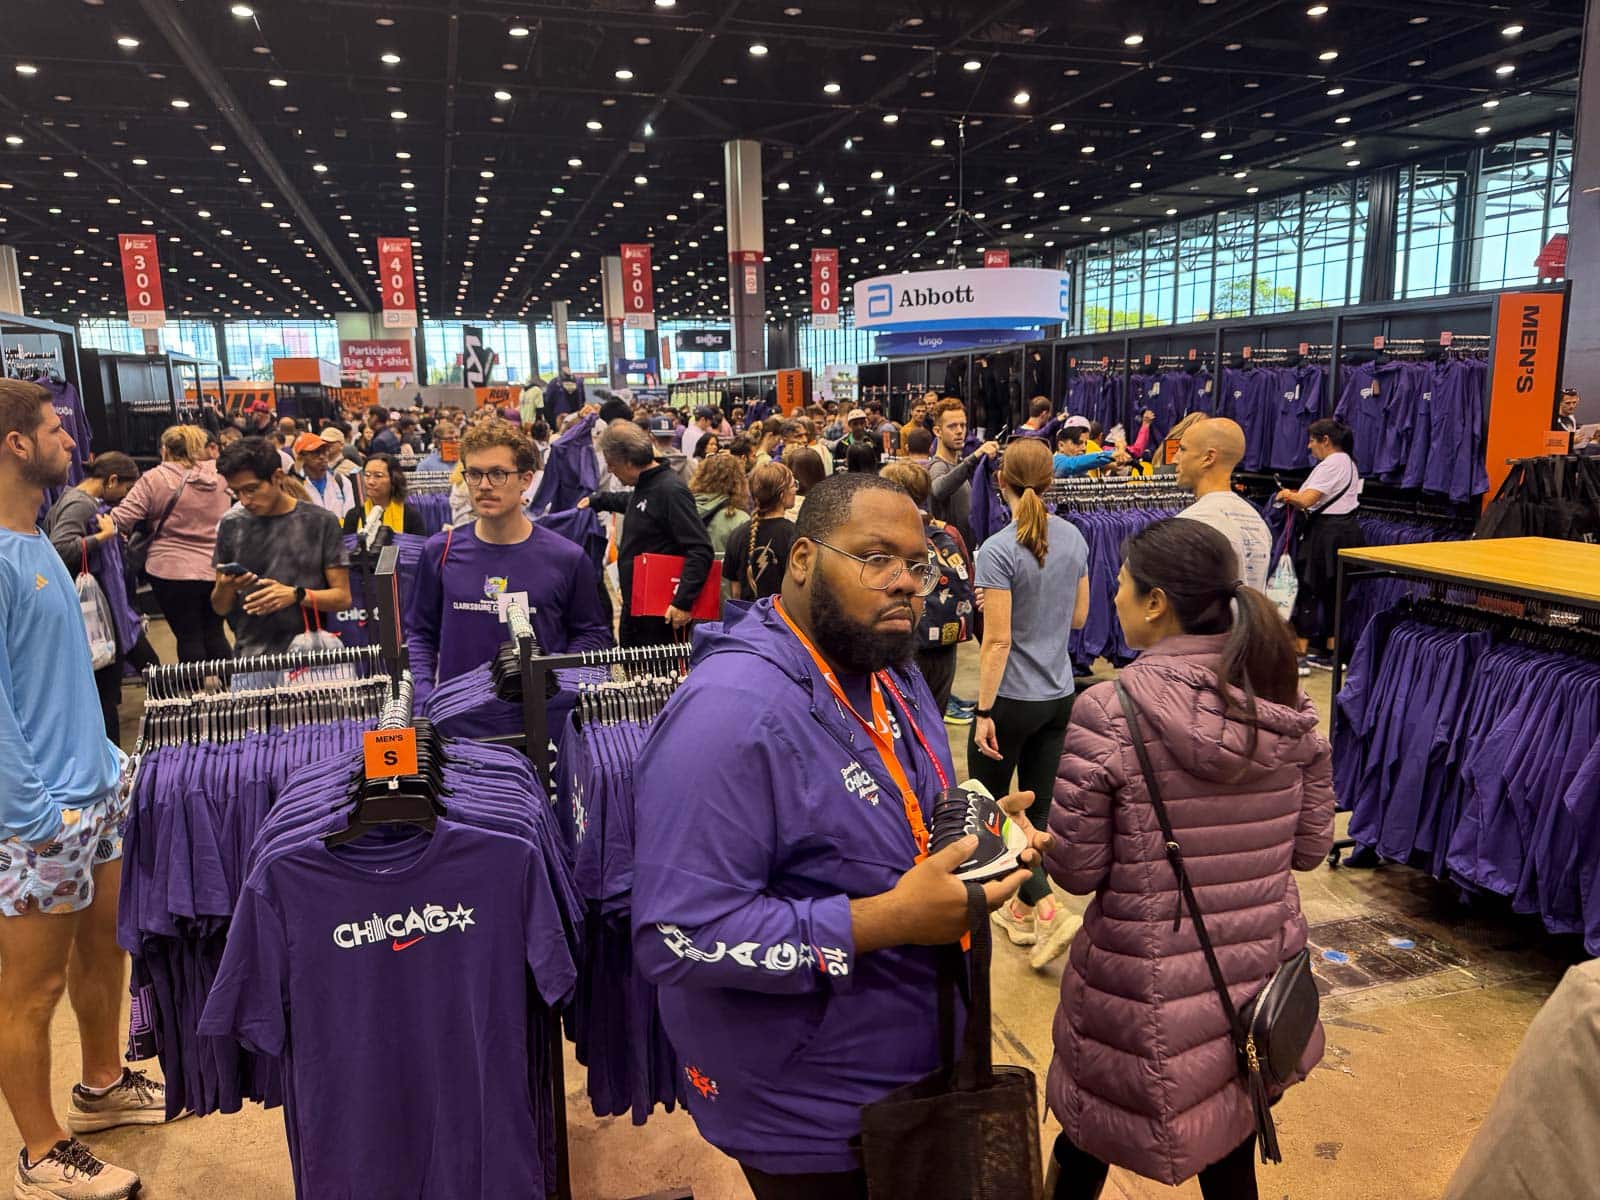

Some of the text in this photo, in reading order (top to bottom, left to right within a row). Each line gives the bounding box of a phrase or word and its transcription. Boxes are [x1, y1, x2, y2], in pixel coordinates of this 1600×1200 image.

[133, 255, 151, 306] 300
[390, 257, 405, 306] 400
[631, 263, 644, 309] 500
[820, 266, 830, 310] 600
[899, 285, 975, 308] Abbott
[348, 345, 402, 356] Participant
[918, 337, 943, 348] Lingo
[1516, 305, 1540, 393] MEN'S
[343, 356, 410, 369] Bag & T-shirt
[375, 735, 404, 743] MEN'S
[383, 750, 398, 766] S
